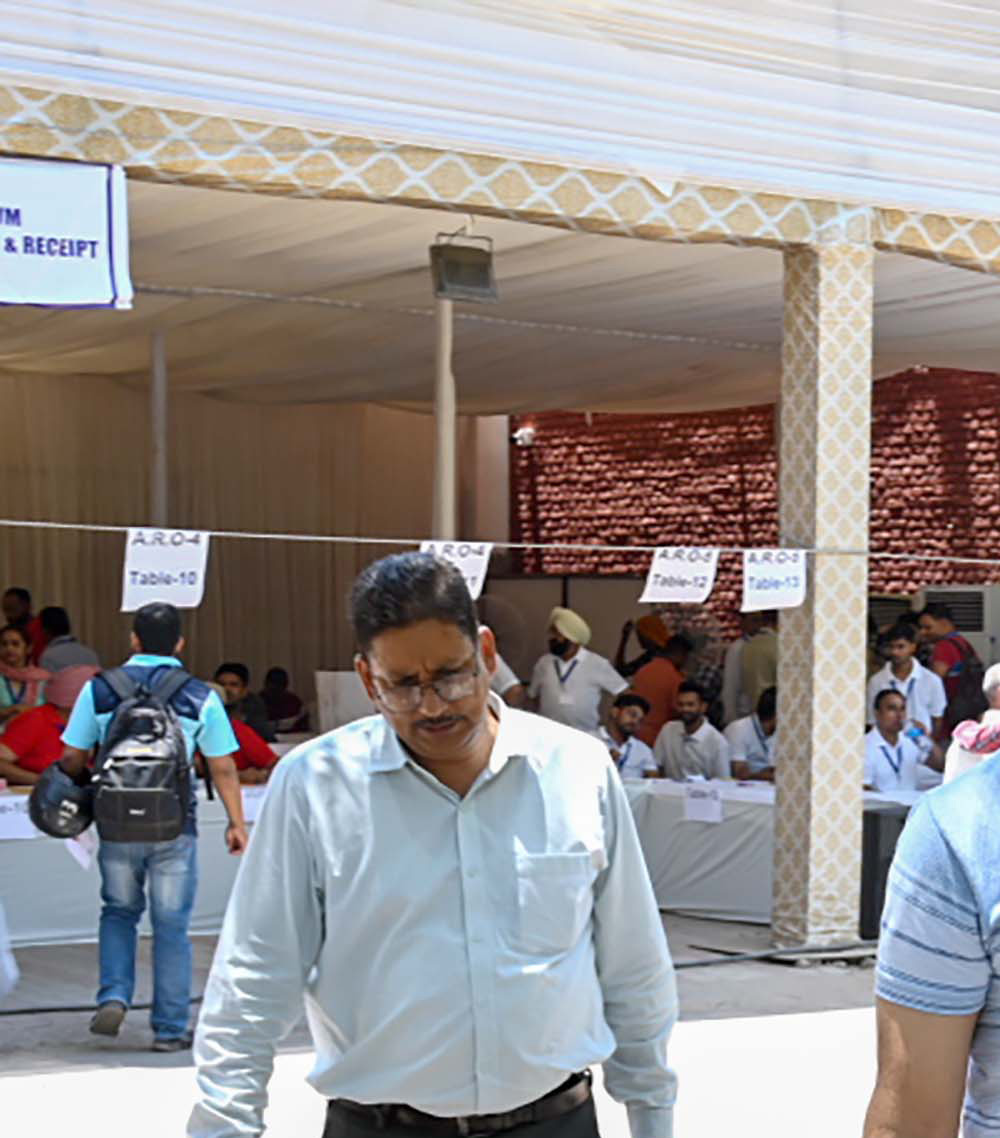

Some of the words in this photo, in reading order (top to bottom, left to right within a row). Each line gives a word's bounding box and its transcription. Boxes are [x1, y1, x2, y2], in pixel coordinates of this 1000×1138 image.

[4, 237, 18, 254] &
[23, 235, 98, 259] RECEIPT
[129, 571, 198, 586] Table-10
